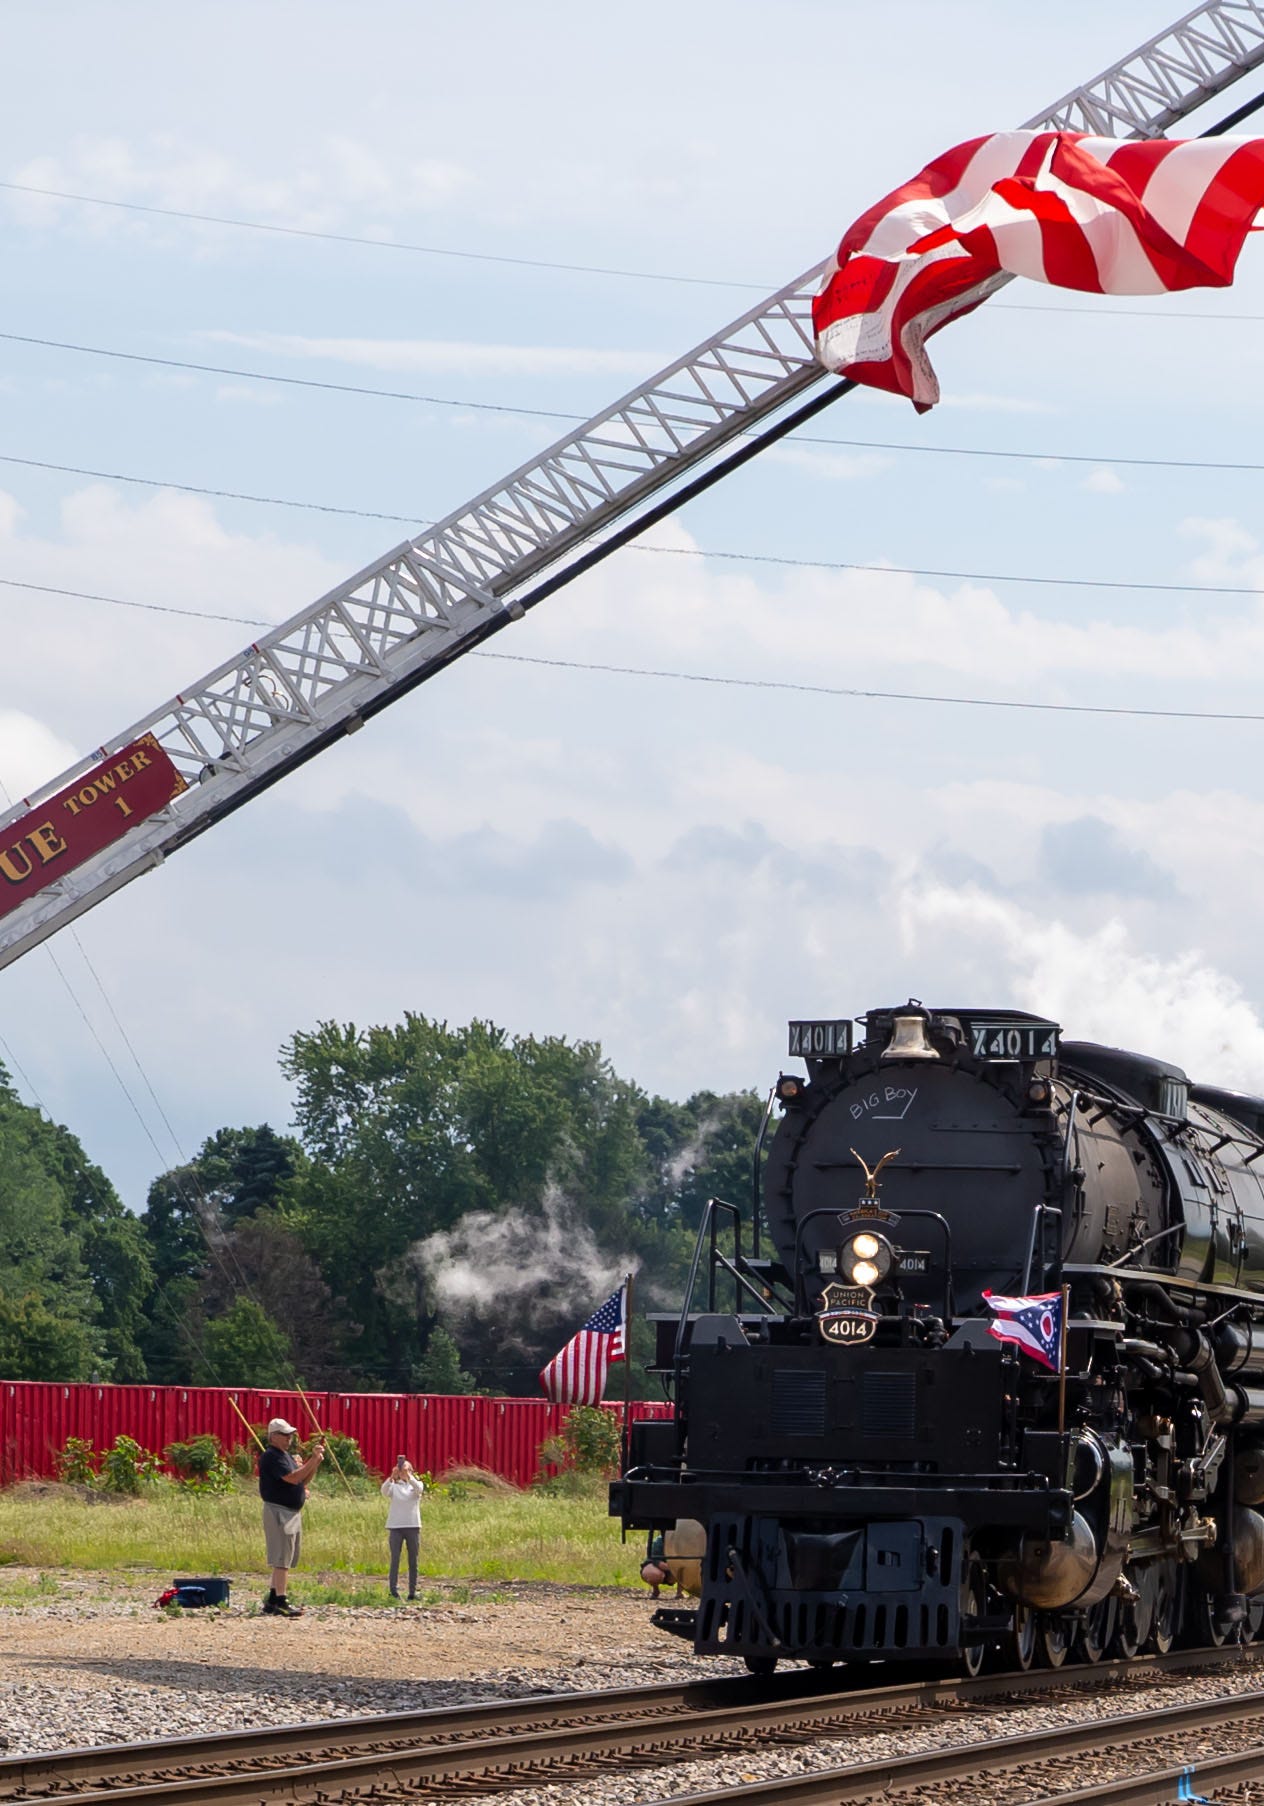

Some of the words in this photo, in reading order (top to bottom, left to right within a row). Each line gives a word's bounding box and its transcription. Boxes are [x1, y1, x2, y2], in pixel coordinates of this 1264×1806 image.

[63, 751, 153, 816] TOWER
[114, 796, 134, 818] 1
[791, 1026, 848, 1053] X4014
[973, 1029, 1057, 1057] X4014
[850, 1092, 880, 1120] BIG
[900, 1258, 925, 1271] 4014
[830, 1298, 866, 1306] PACIFIC
[828, 1320, 867, 1336] 4014
